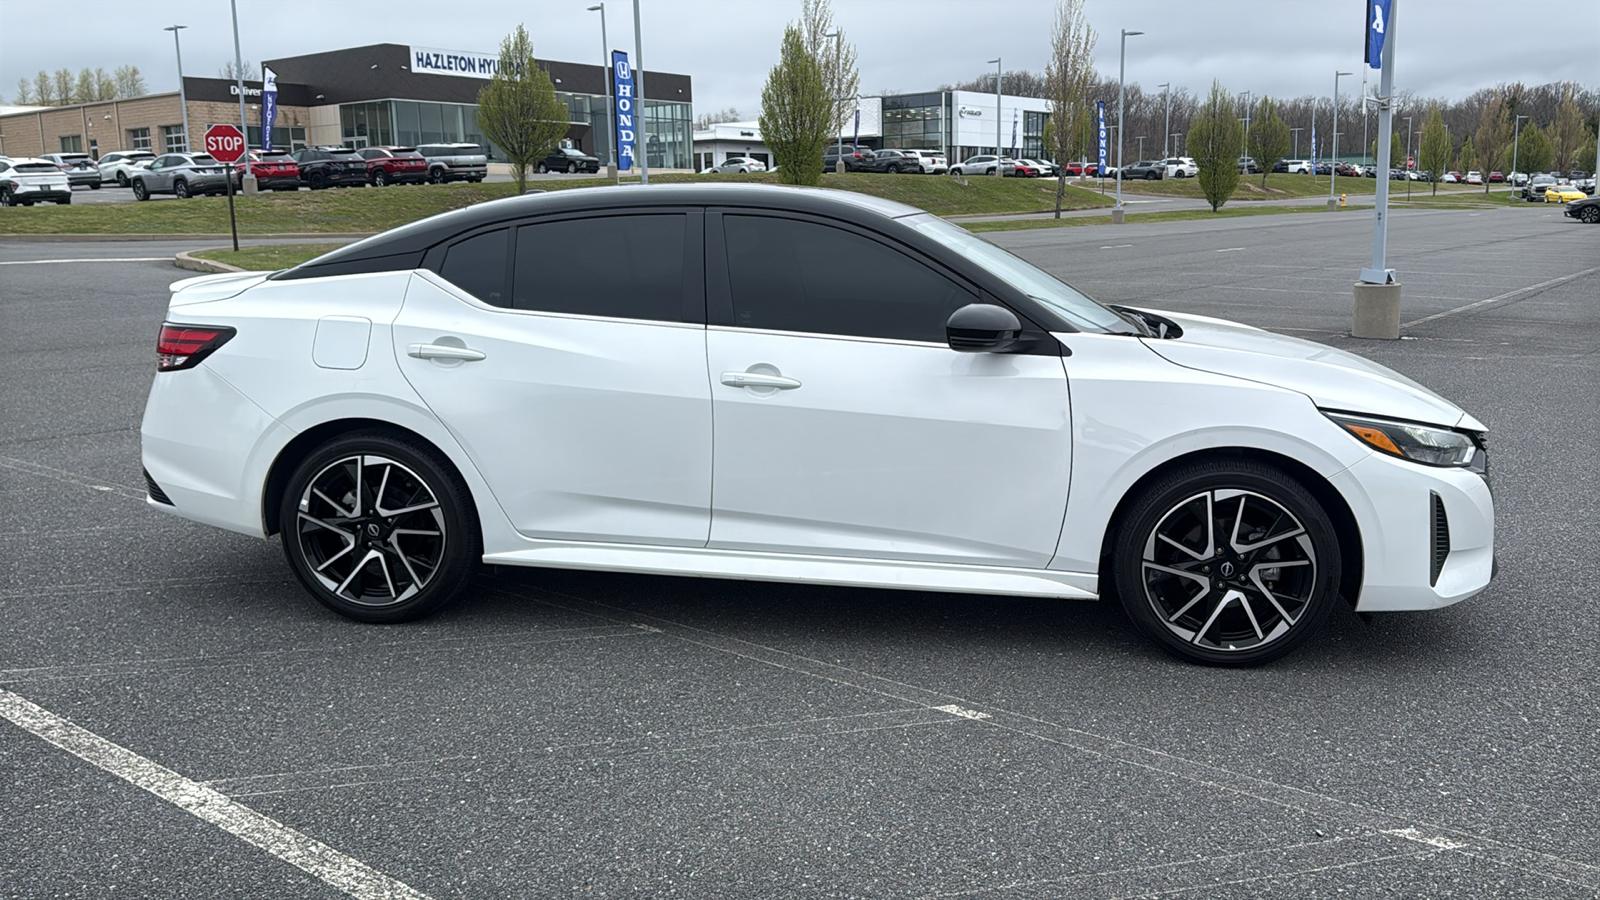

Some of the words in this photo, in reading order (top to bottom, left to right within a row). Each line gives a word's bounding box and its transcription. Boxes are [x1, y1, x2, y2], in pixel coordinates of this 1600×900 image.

[416, 51, 476, 73] HAZLETON
[478, 57, 526, 78] HYUNDA
[229, 85, 262, 97] Dliver
[618, 84, 634, 157] HONDA
[207, 136, 243, 151] STOP
